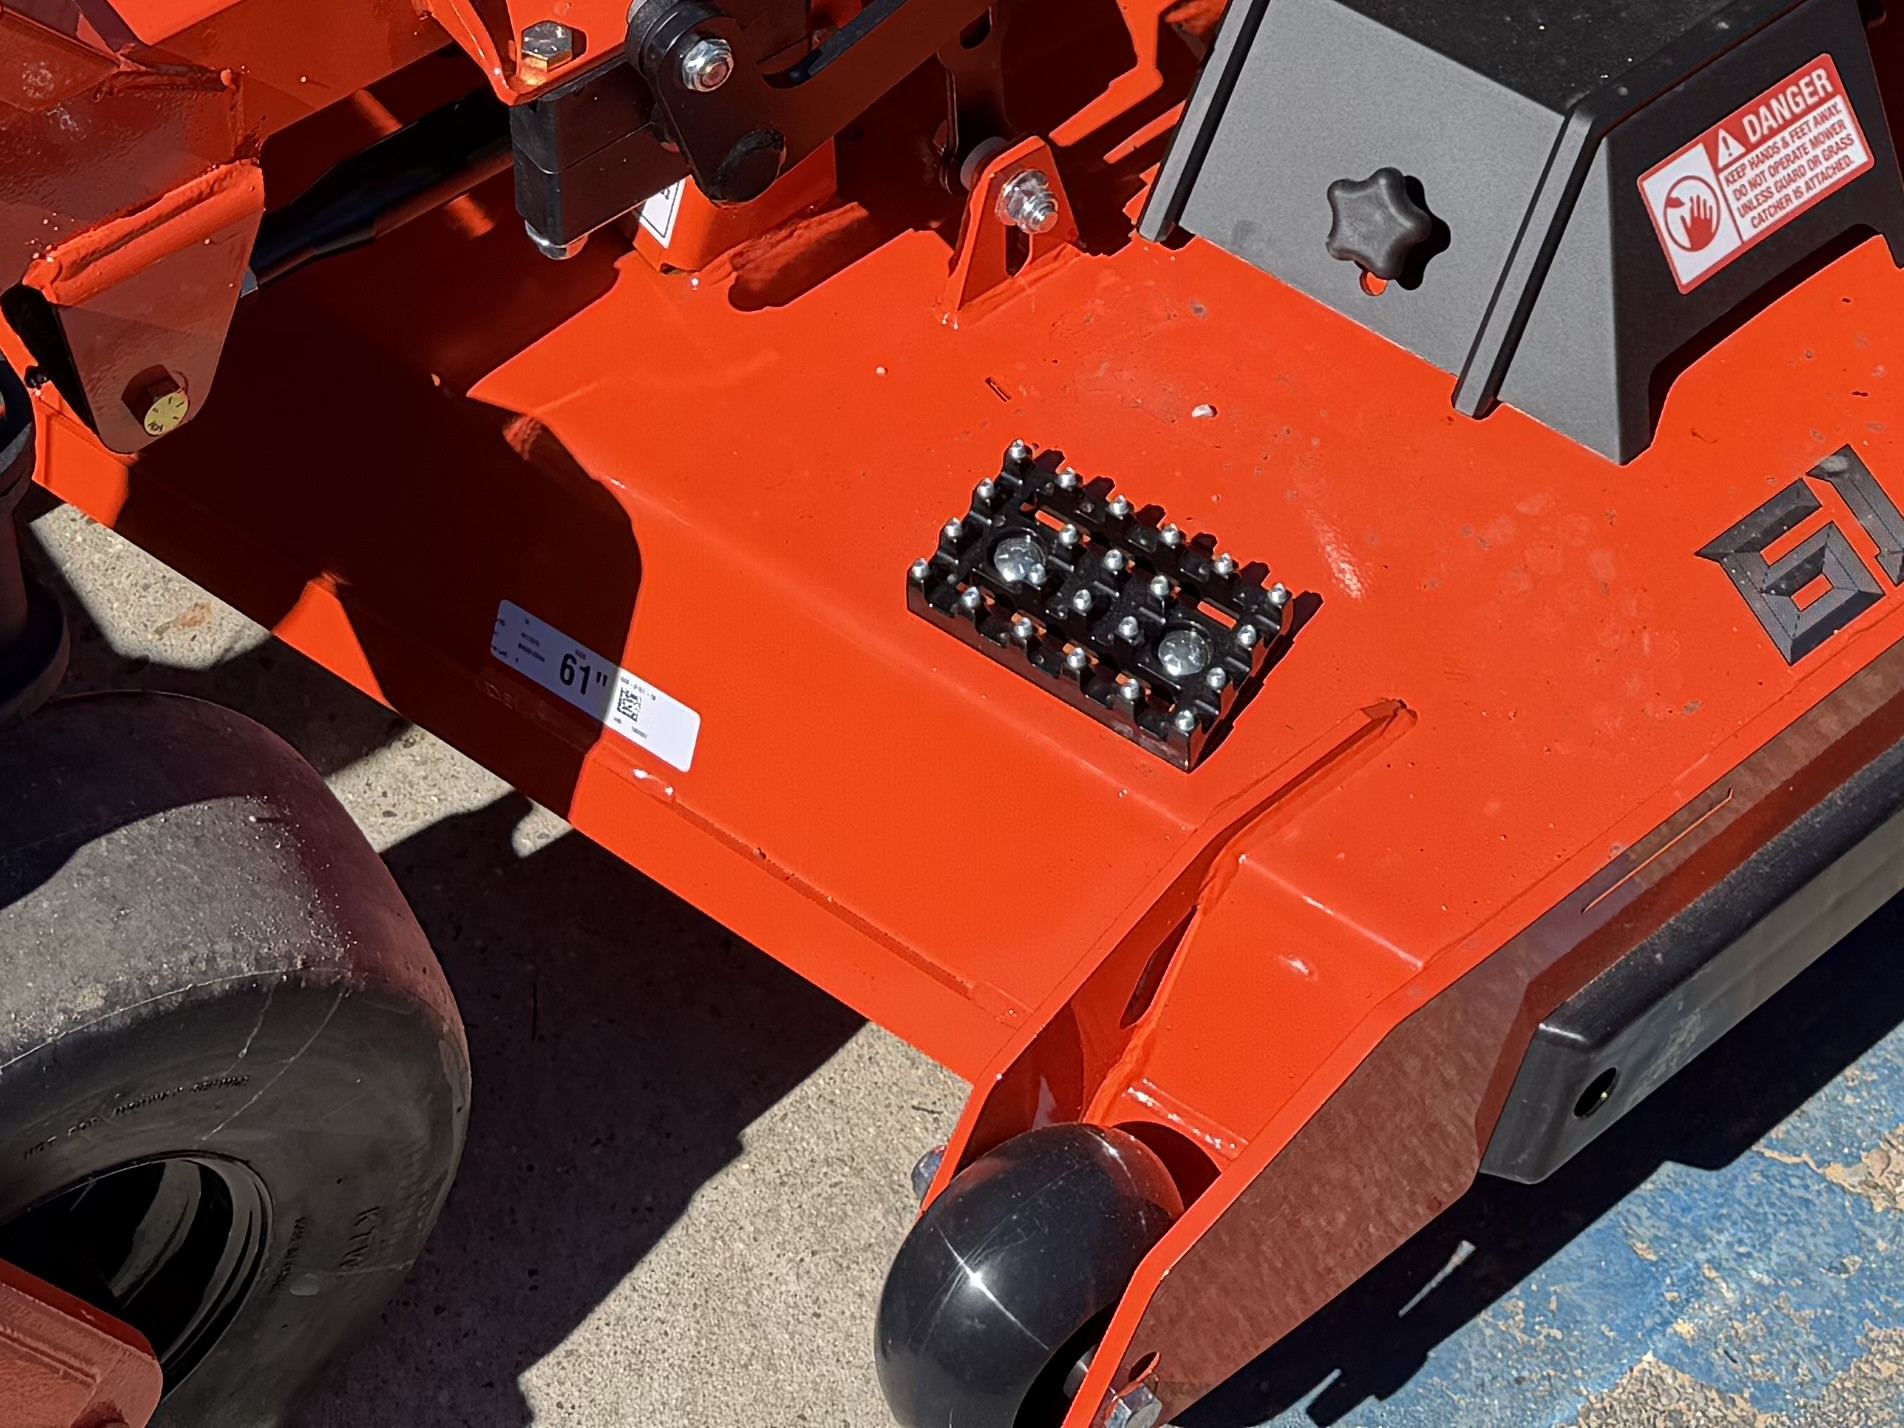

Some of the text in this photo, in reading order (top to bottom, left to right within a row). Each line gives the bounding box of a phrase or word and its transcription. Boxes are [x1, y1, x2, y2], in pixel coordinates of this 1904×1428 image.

[1742, 69, 1833, 143] DANGER
[1725, 164, 1747, 187] KEEP
[1750, 143, 1781, 170] HANDS
[1790, 122, 1811, 142] FEET
[1733, 121, 1846, 201] DO NOT OPERATE MOWER
[1737, 134, 1854, 217] UNLESS GUARD OR GRASS
[1751, 195, 1792, 228] CATCHER
[1794, 186, 1803, 202] IS
[559, 652, 608, 695] 61"
